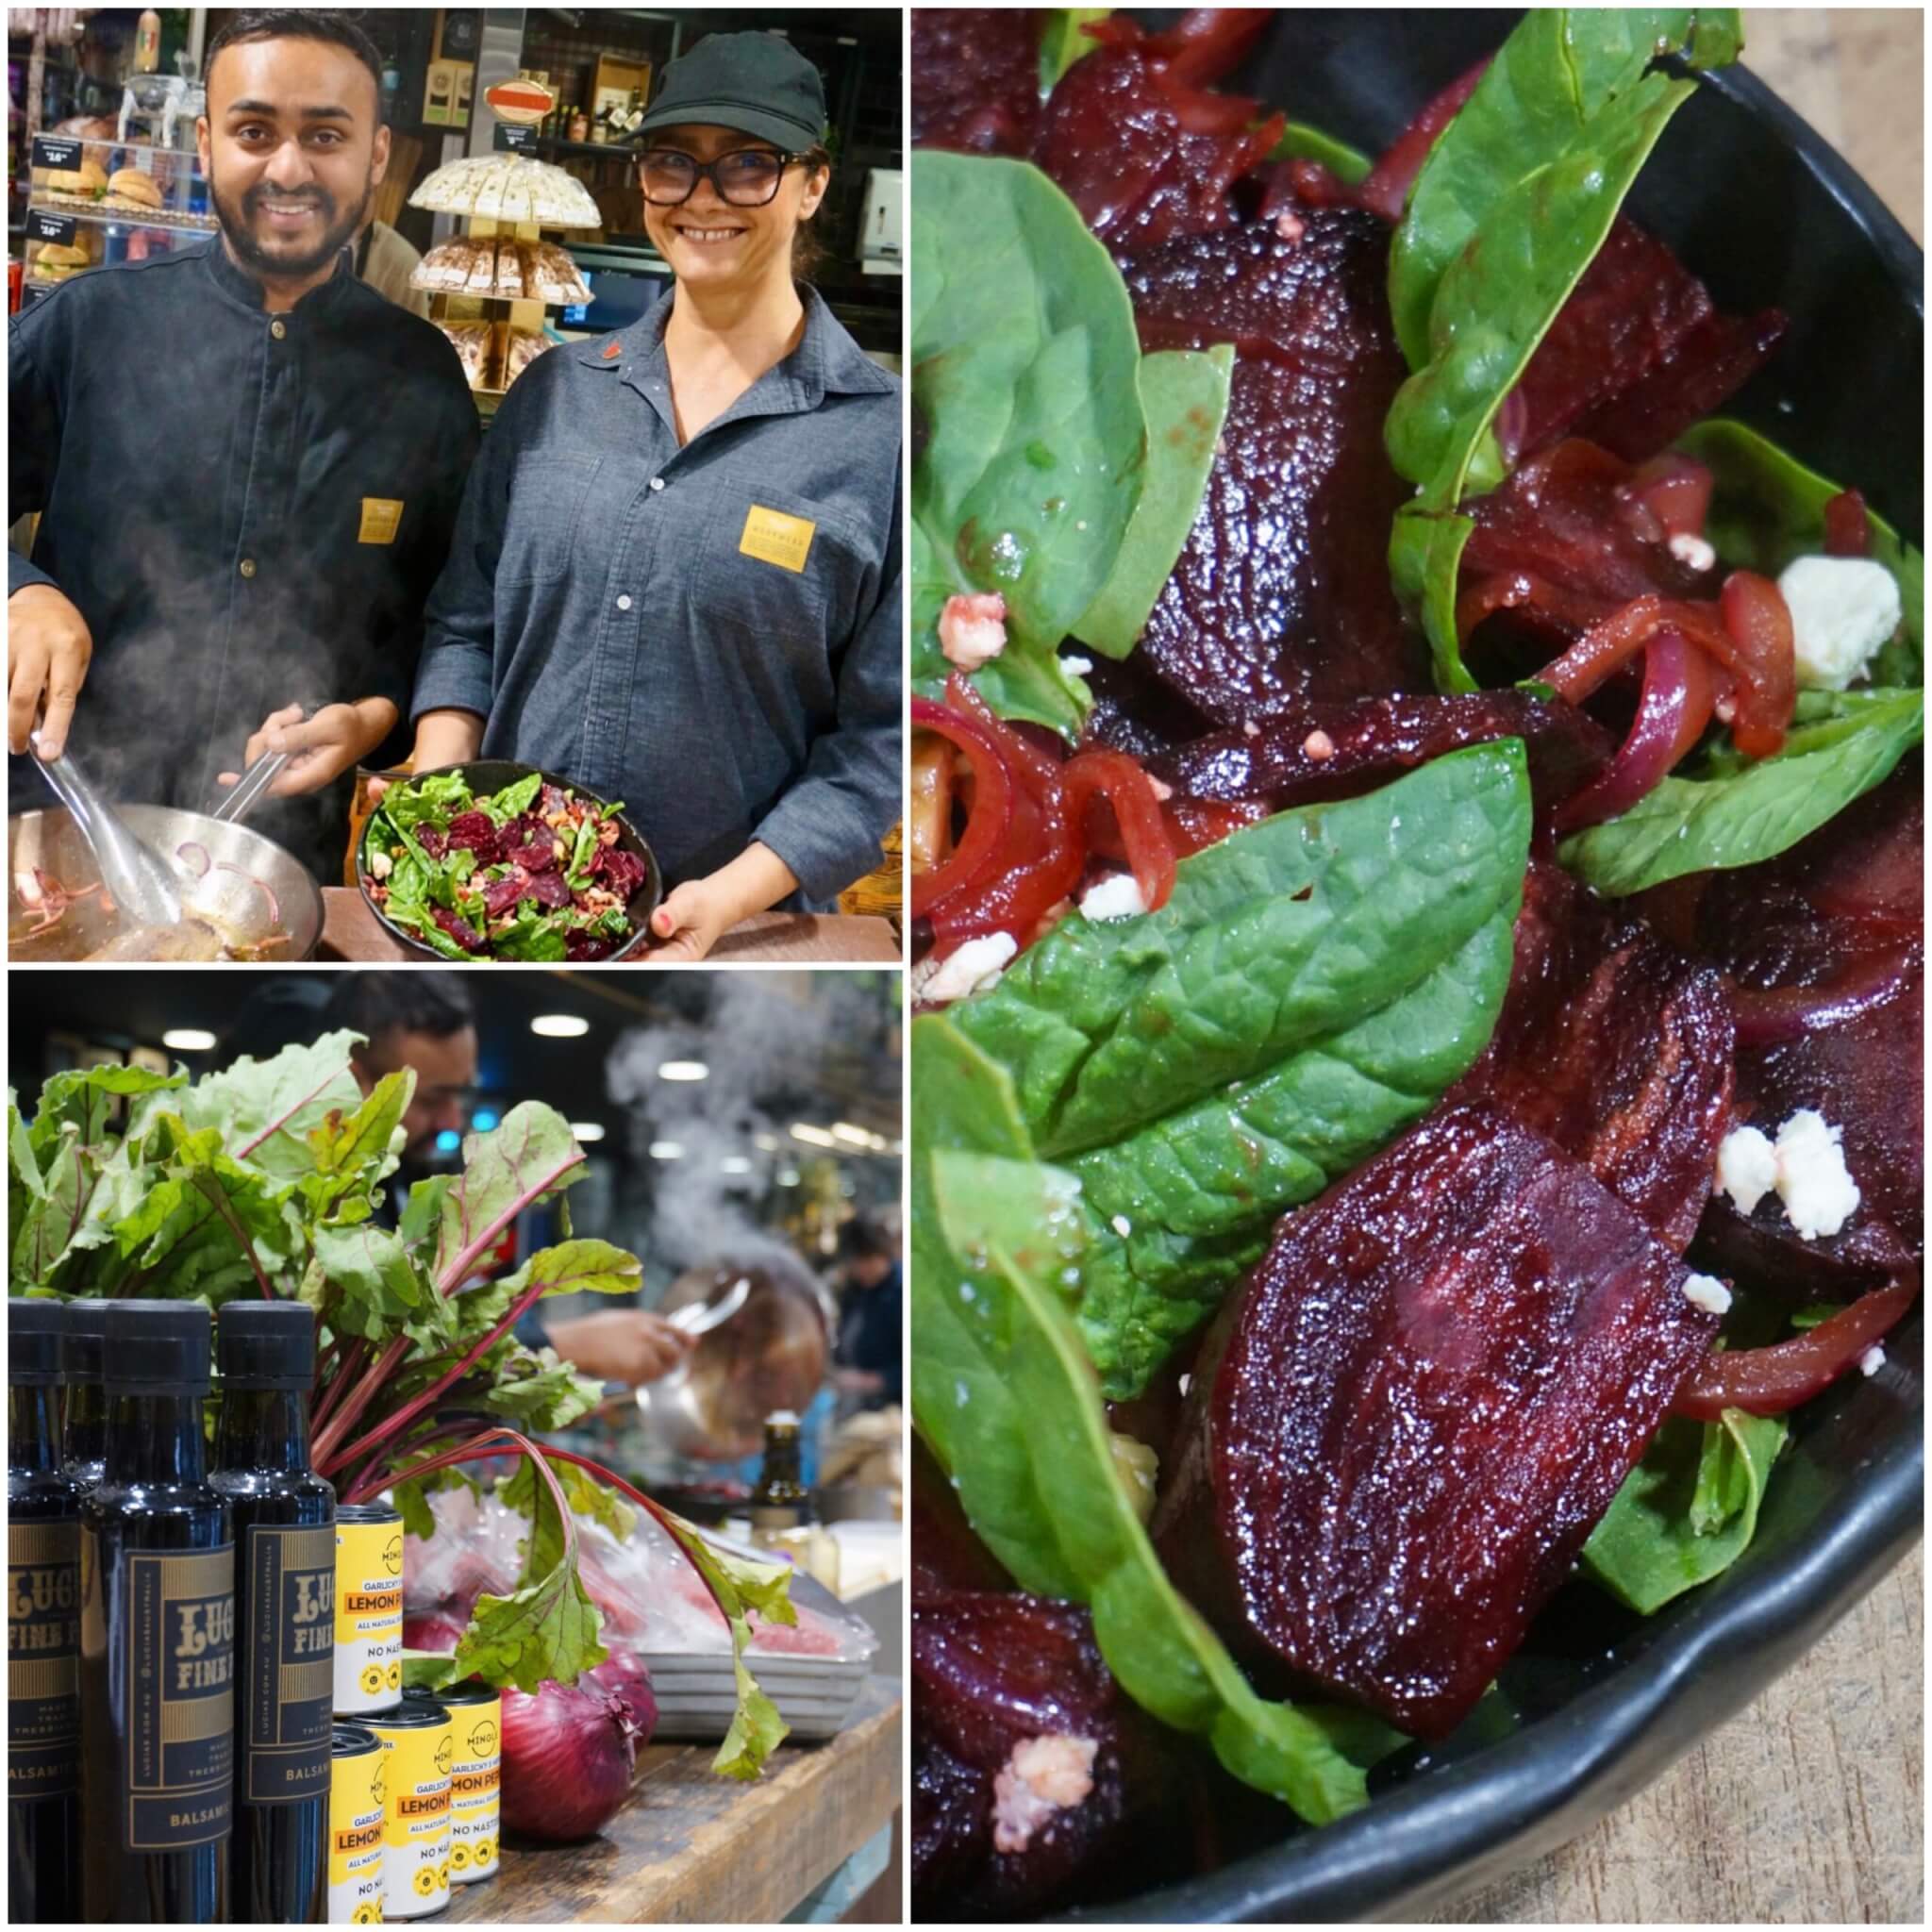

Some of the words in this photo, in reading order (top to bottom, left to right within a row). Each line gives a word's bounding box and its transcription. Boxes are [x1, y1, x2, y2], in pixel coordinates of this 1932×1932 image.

[348, 1594, 394, 1611] LEMON
[367, 1646, 384, 1658] NO
[401, 1795, 445, 1814] LEMON
[453, 1825, 470, 1836] NO
[339, 1826, 381, 1850] LEMON
[420, 1847, 436, 1860] NO
[358, 1882, 374, 1896] NO
